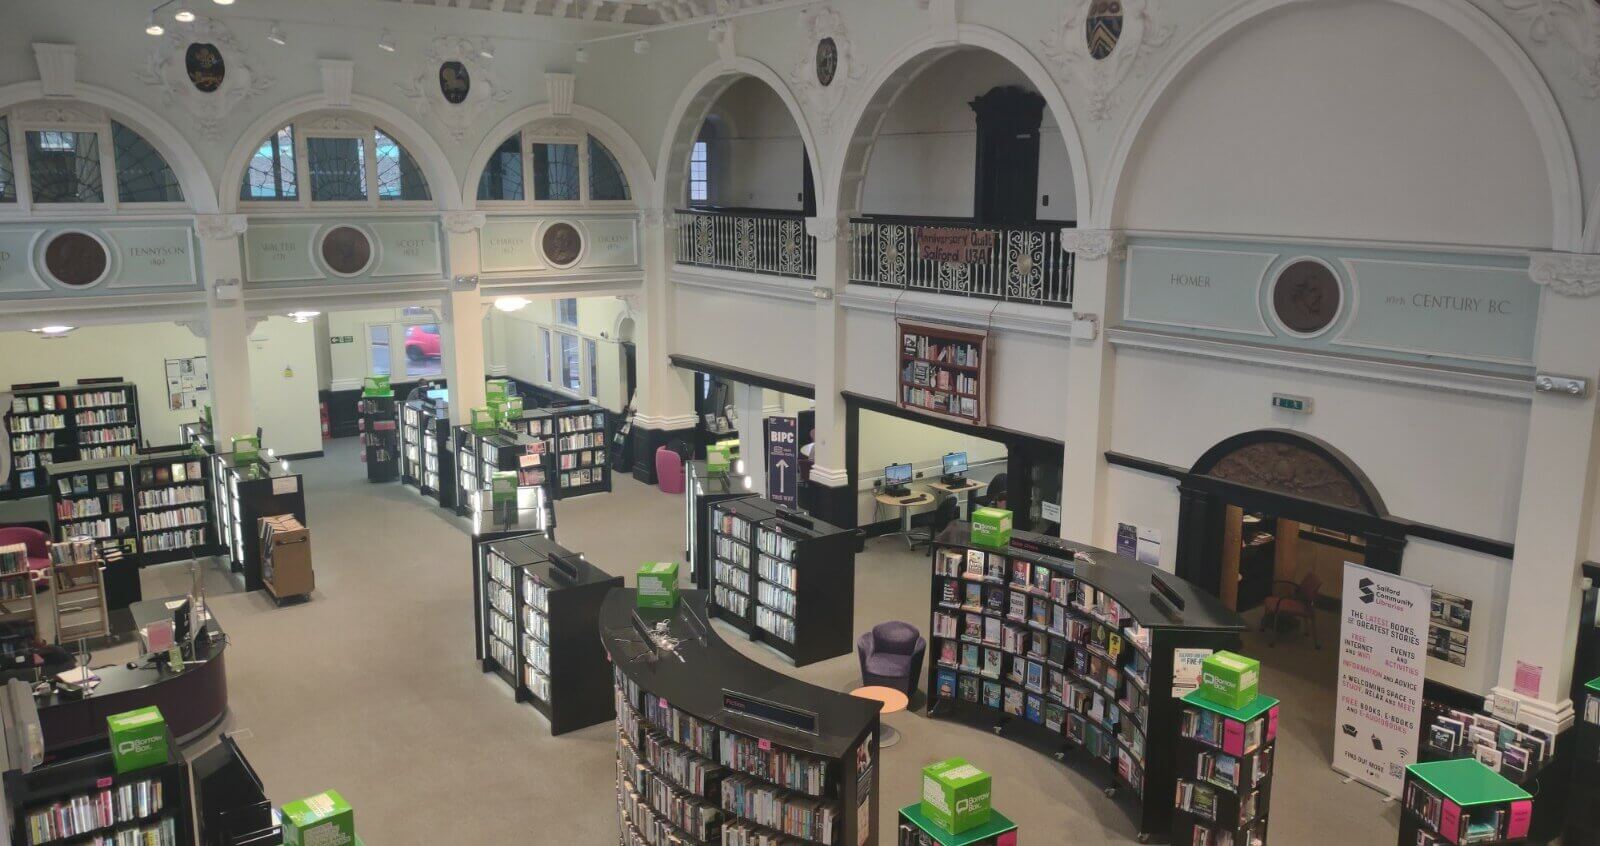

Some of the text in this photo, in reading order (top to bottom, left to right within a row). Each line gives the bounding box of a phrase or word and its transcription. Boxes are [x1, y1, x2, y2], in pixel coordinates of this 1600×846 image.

[916, 227, 993, 247] Anniversary Quilt
[130, 247, 185, 257] TENNYSON
[923, 246, 959, 261] Salford
[1170, 272, 1211, 288] HOMER
[1412, 292, 1483, 314] CENTURY
[1487, 299, 1512, 316] BC
[771, 431, 794, 444] BIPC
[1376, 584, 1400, 596] Salford
[1375, 591, 1413, 608] Community
[1375, 599, 1404, 612] Libraries
[1350, 609, 1364, 620] THE
[1365, 615, 1389, 627] LATEST
[1351, 633, 1367, 642] FREE
[1356, 619, 1390, 636] GREATEST
[1390, 630, 1420, 646] STORIES
[1344, 639, 1373, 654] INTERNET
[1345, 648, 1356, 656] AND
[1390, 646, 1415, 660] EVENTS
[1396, 656, 1408, 665] AND
[1342, 660, 1417, 691] INFORMATION AND ADVICE
[1384, 660, 1419, 677] ACTIVITIES
[1348, 675, 1385, 694] WELCOMING
[1386, 689, 1407, 702] SPACE
[1408, 698, 1416, 706] TO
[1364, 688, 1383, 701] RELAX
[1384, 697, 1396, 706] AND
[1397, 702, 1415, 713] MEET
[1342, 695, 1359, 707] FREE
[1384, 712, 1414, 730] E-BOOKS
[1346, 706, 1358, 715] AND
[134, 735, 163, 747] Borrow
[1344, 750, 1357, 761] FIND
[1368, 760, 1385, 773] MORE
[968, 792, 990, 805] Borrow
